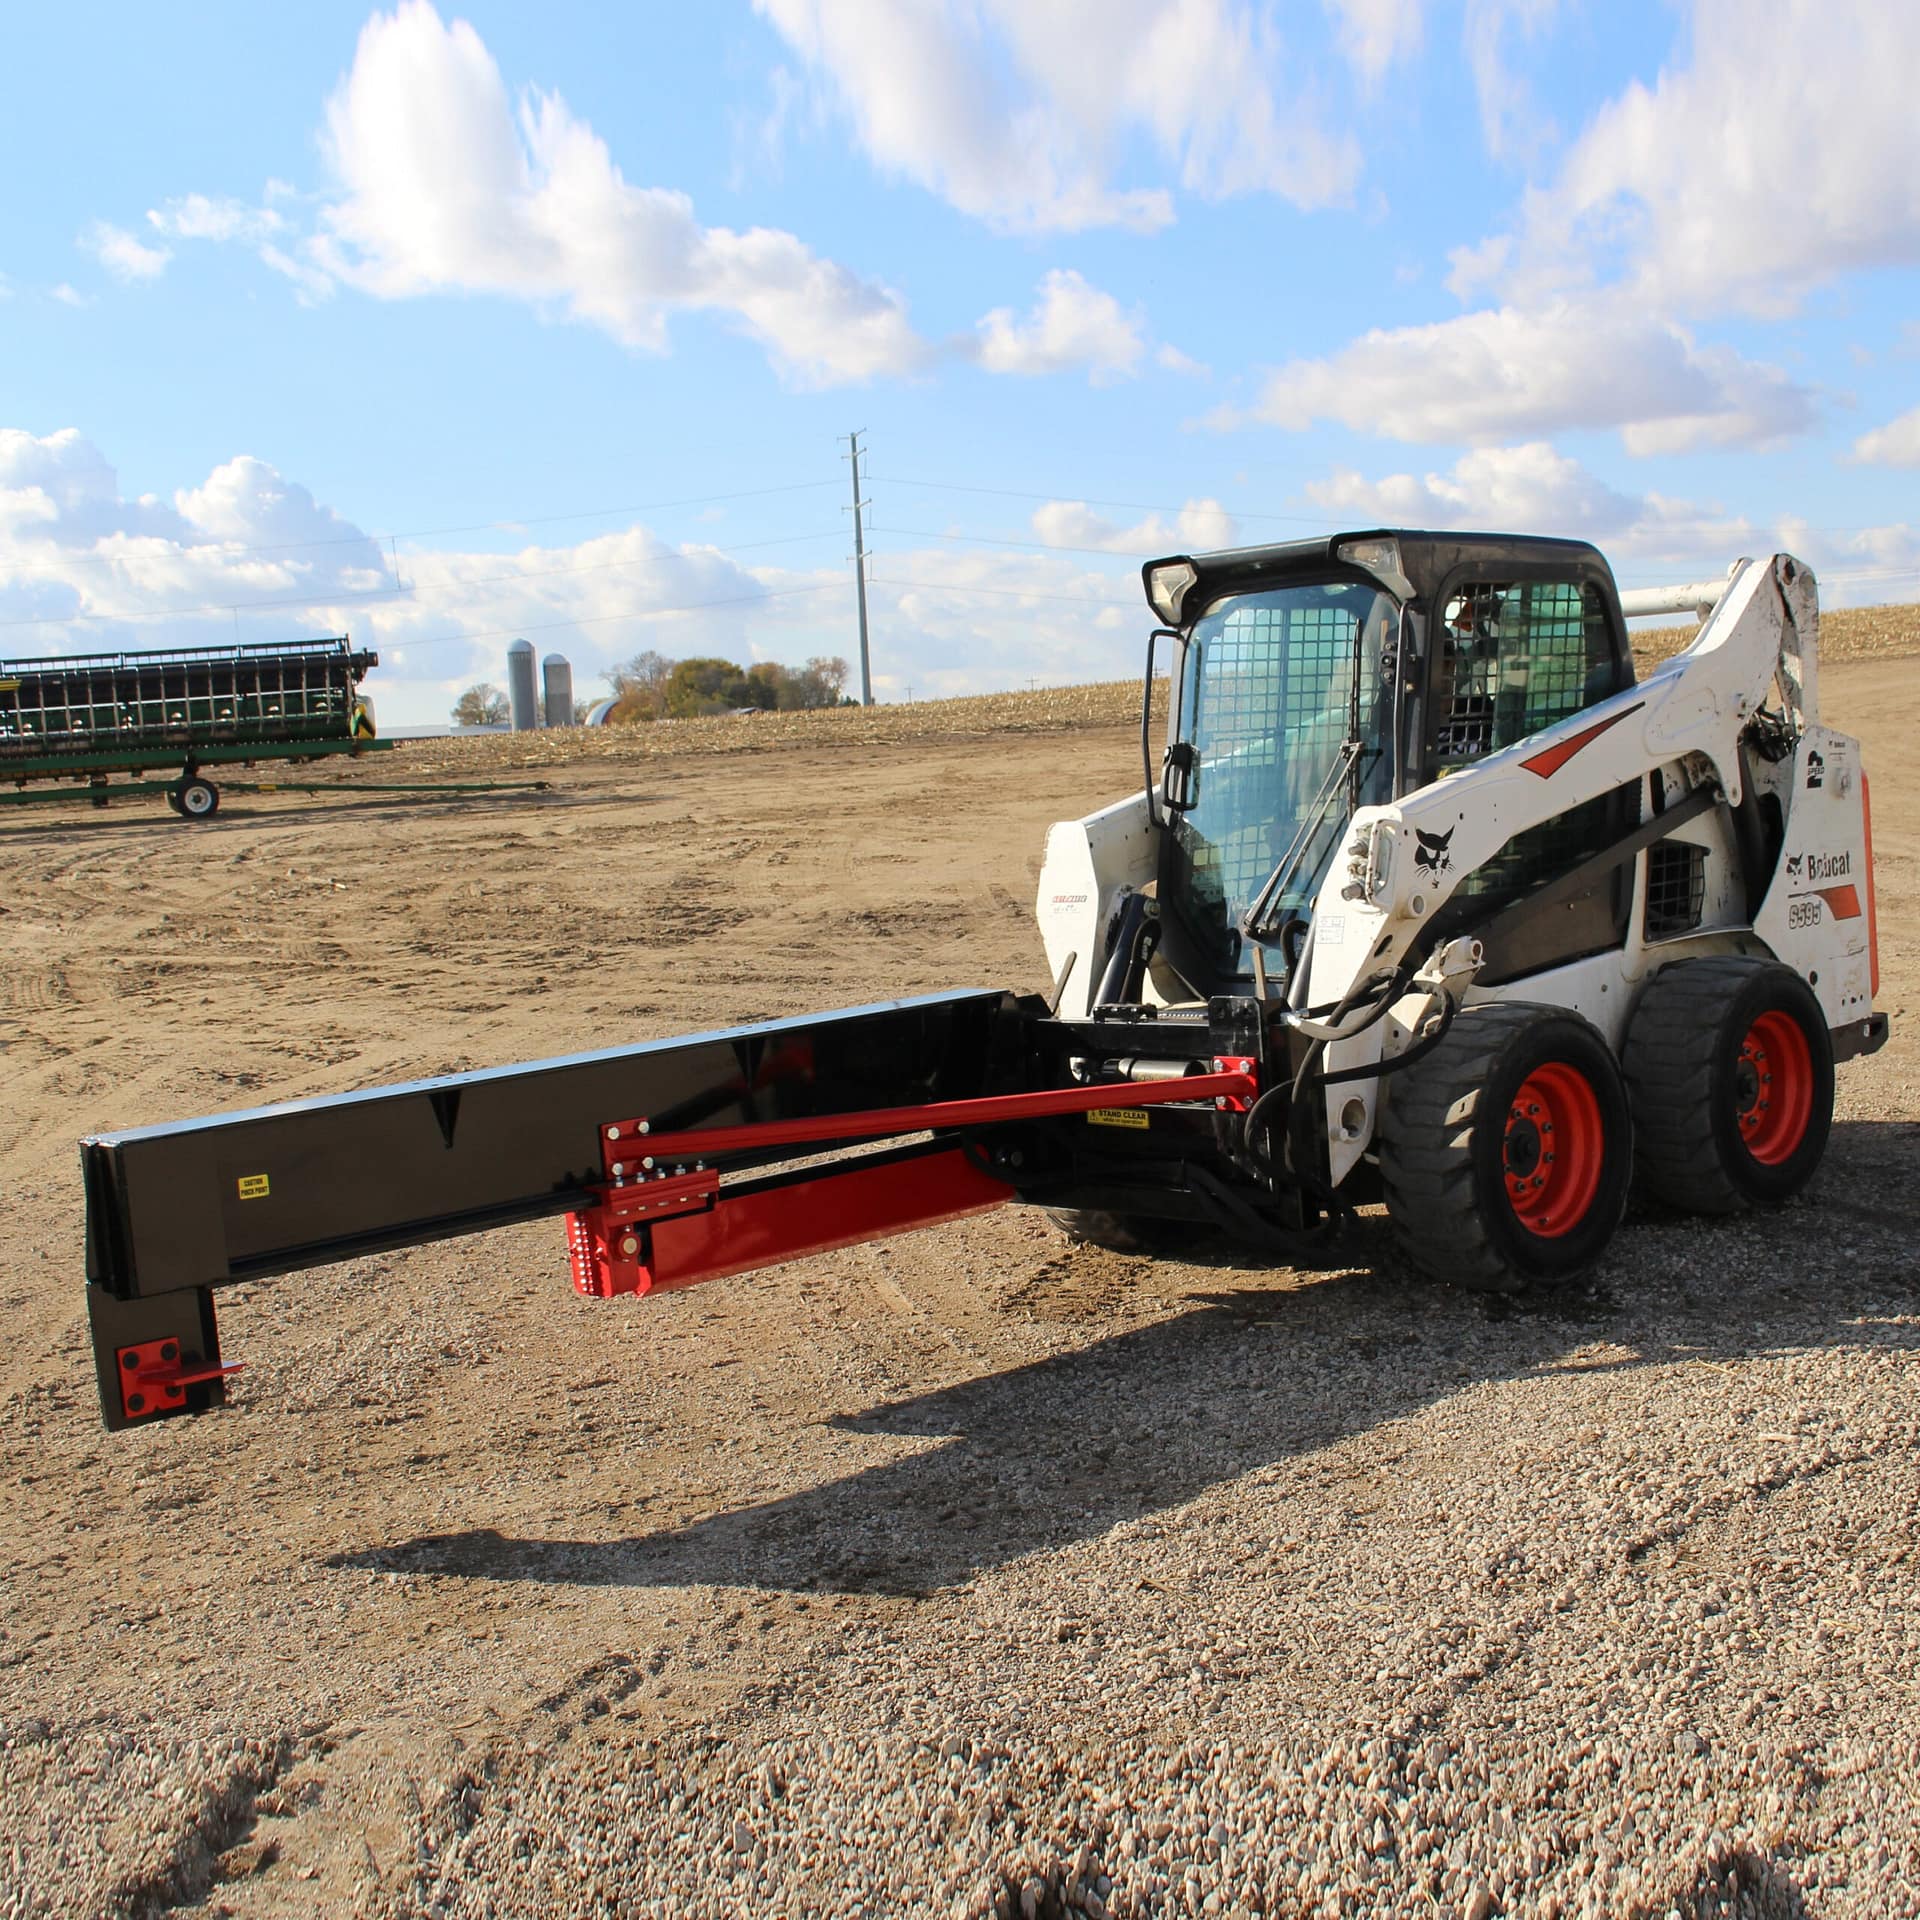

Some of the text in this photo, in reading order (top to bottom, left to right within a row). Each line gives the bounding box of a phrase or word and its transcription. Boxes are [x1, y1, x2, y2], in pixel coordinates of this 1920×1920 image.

[1807, 766, 1825, 776] SPEED
[1807, 850, 1850, 880] Bobcat
[1789, 901, 1822, 930] S595
[1099, 1110, 1147, 1120] STAND CLEAR
